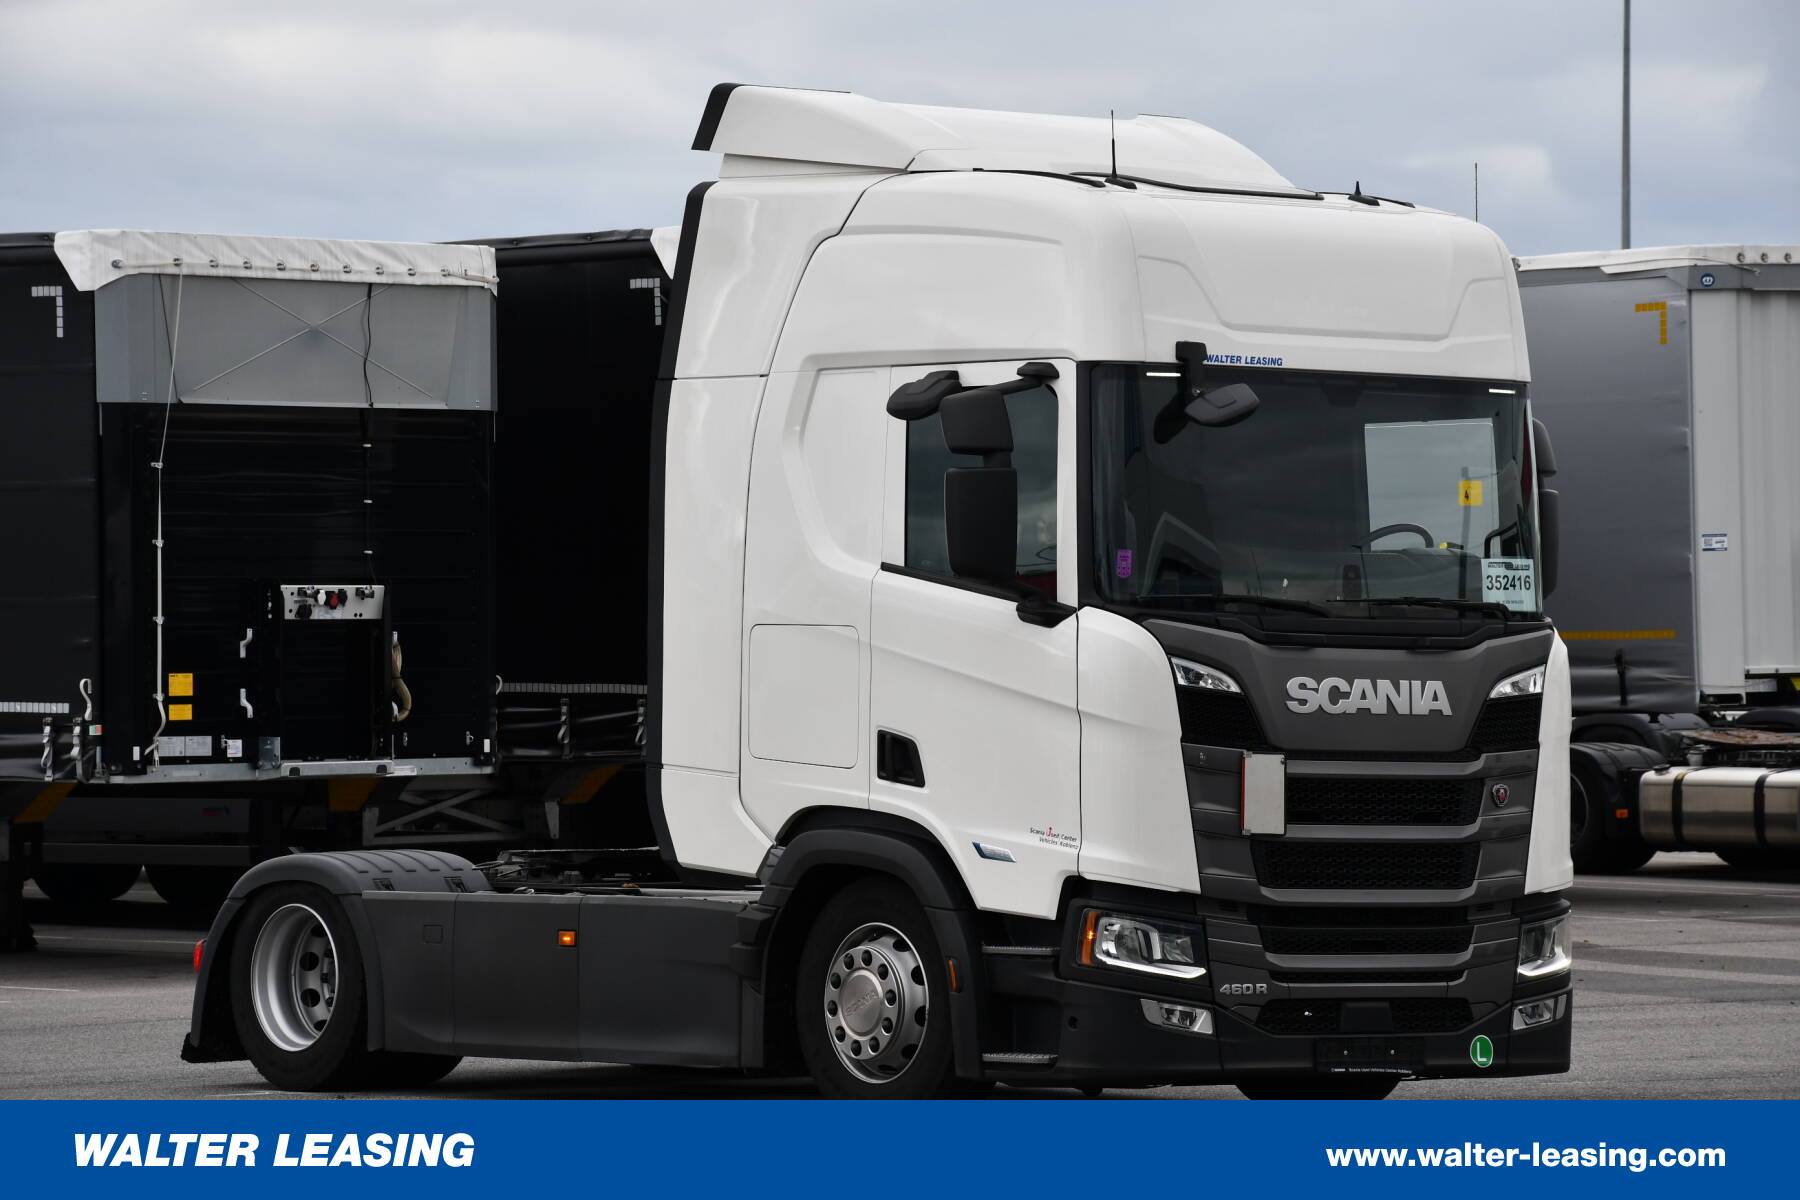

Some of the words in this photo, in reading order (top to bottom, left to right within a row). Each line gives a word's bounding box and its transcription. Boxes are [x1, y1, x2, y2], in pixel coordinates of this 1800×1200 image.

[1206, 354, 1242, 364] WALTER
[1244, 356, 1283, 367] LEASING
[1486, 574, 1531, 591] 352416
[1285, 676, 1453, 716] SCANIA
[1220, 984, 1254, 995] 460
[1255, 984, 1267, 995] R
[1477, 1041, 1487, 1061] L
